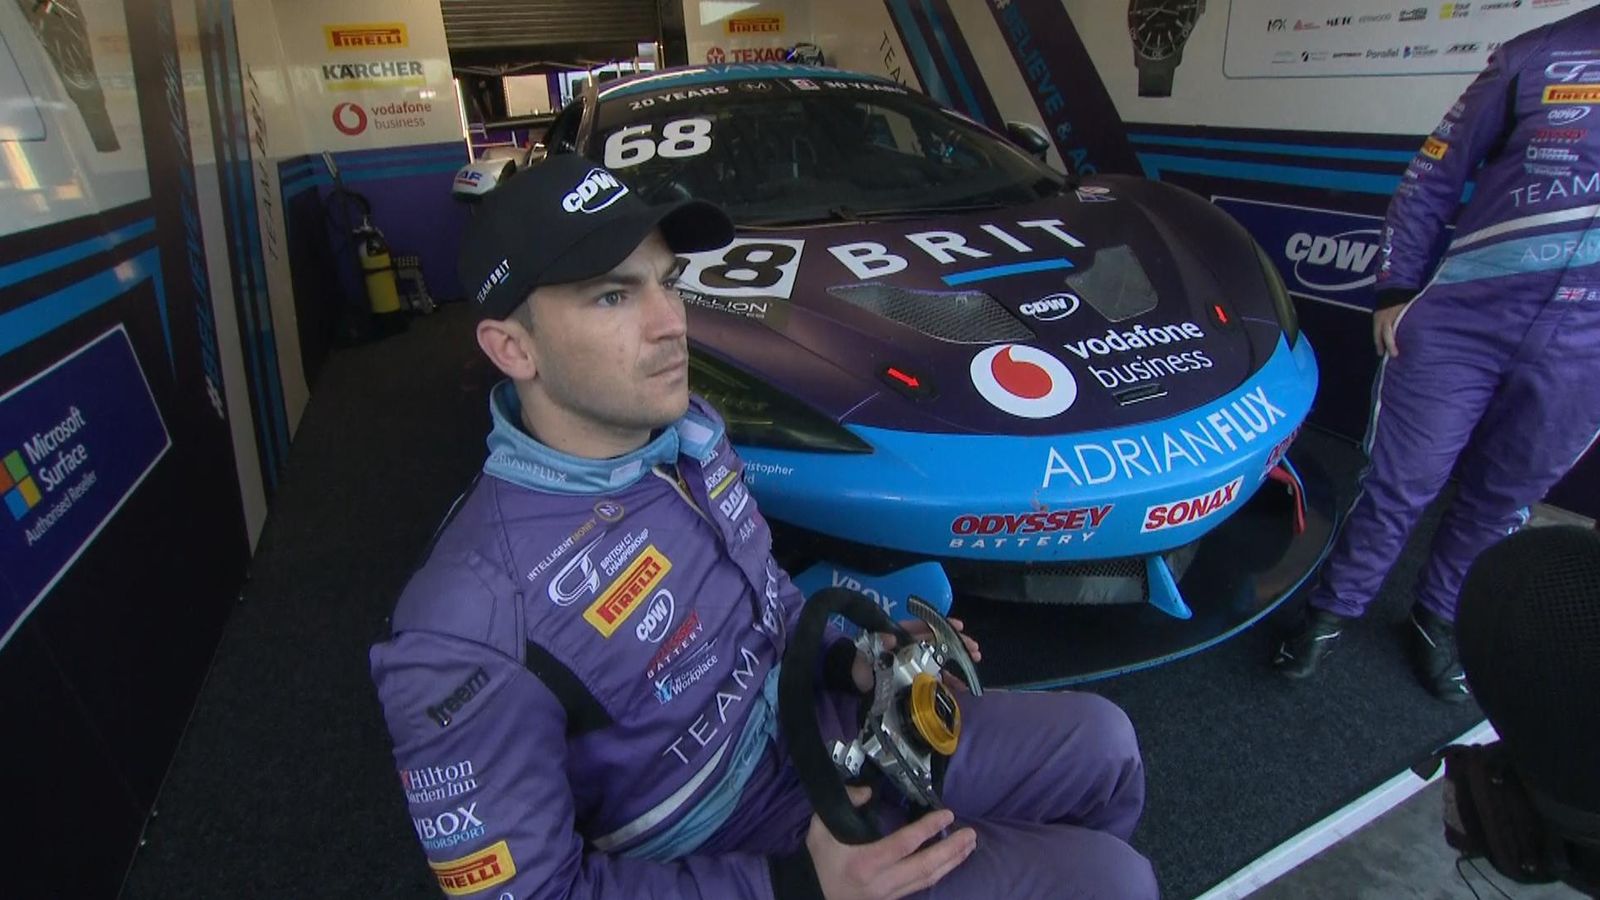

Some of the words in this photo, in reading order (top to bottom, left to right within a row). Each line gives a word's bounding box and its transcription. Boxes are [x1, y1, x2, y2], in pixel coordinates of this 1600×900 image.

[332, 29, 403, 48] PIRELLI
[729, 18, 781, 33] PIRELLI
[322, 61, 424, 80] KÄRCHER
[371, 102, 432, 117] vodafone
[629, 99, 655, 111] 20
[658, 85, 729, 103] YEARS
[374, 116, 426, 130] business
[604, 117, 713, 170] 68
[562, 170, 622, 213] CDW
[1509, 172, 1600, 208] TEAM
[827, 219, 1086, 280] BRIT
[1284, 231, 1380, 273] CDW
[477, 280, 493, 304] TEAM
[490, 259, 510, 285] BRIT
[1063, 321, 1205, 361] vodafone
[1088, 349, 1213, 389] business
[23, 405, 87, 465] Microsoft
[1042, 386, 1288, 489] ADRIANFLUX
[38, 443, 89, 493] Surface
[25, 492, 73, 547] Authorised
[67, 470, 98, 503] Reseller
[951, 503, 1115, 537] ODYSSEY
[1144, 480, 1240, 531] SONAX
[600, 540, 626, 571] BRITISH
[605, 528, 650, 577] CHAMPIONSHIP
[949, 531, 1096, 549] BATTERY
[596, 556, 662, 626] PIRELLI
[635, 597, 670, 642] CDW
[646, 622, 703, 680] BATTERY
[671, 654, 719, 696] Workplace
[662, 647, 760, 765] TEAM
[409, 759, 474, 790] Hilton
[447, 777, 479, 798] Inn
[412, 801, 483, 841] VBOX
